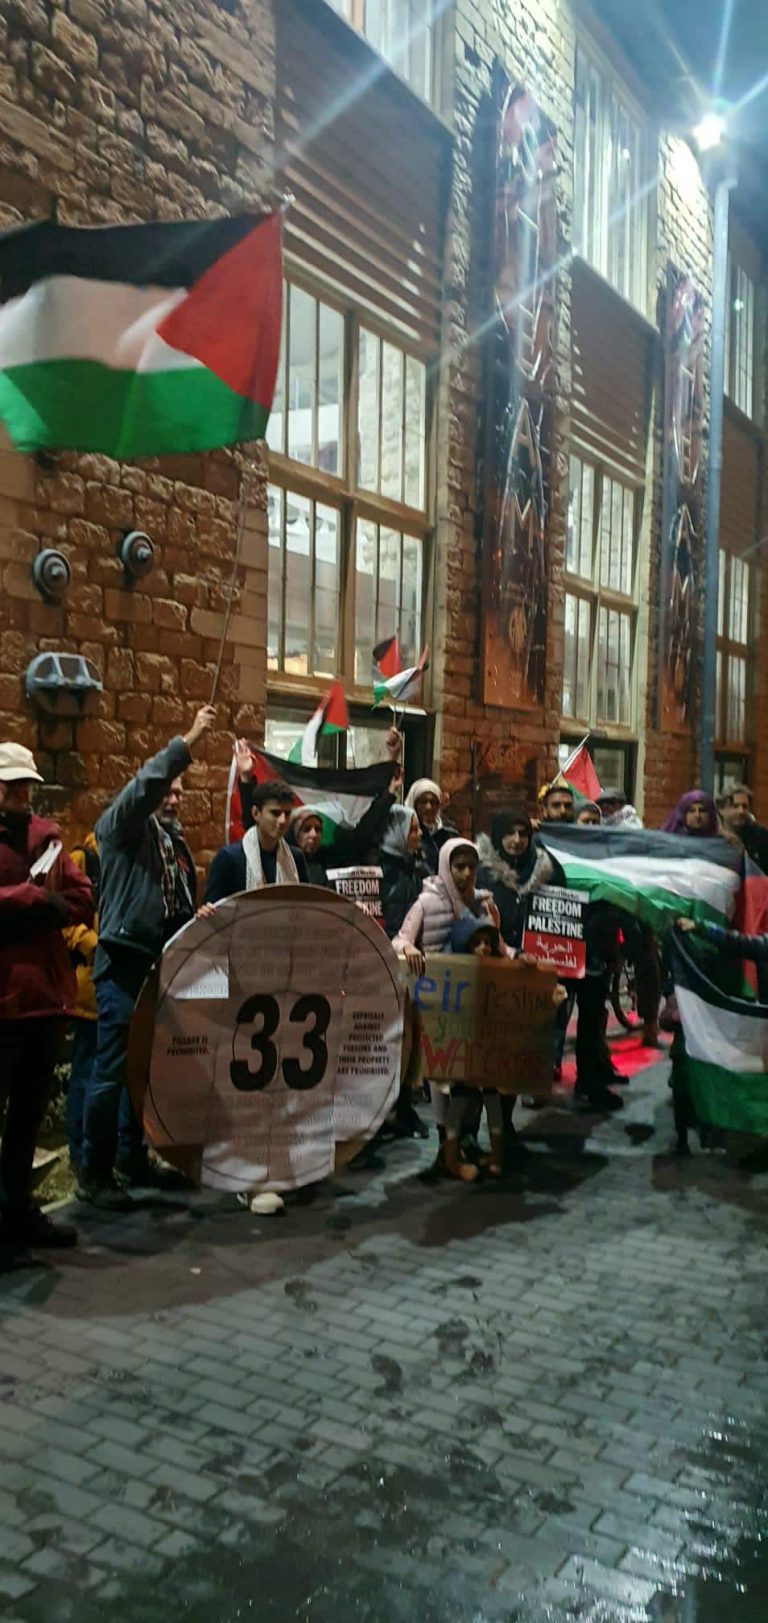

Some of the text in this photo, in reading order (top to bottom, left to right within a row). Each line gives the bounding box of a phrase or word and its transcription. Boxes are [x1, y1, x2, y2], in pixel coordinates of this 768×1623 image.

[335, 879, 380, 896] FREEDOM
[532, 895, 582, 918] FREEDOM
[528, 914, 584, 939] PALESTINE
[229, 993, 331, 1091] 33
[348, 1033, 384, 1042] PROTECTED
[373, 1044, 388, 1053] AND
[357, 1055, 390, 1065] PROPERTY
[336, 1067, 350, 1075] ARE
